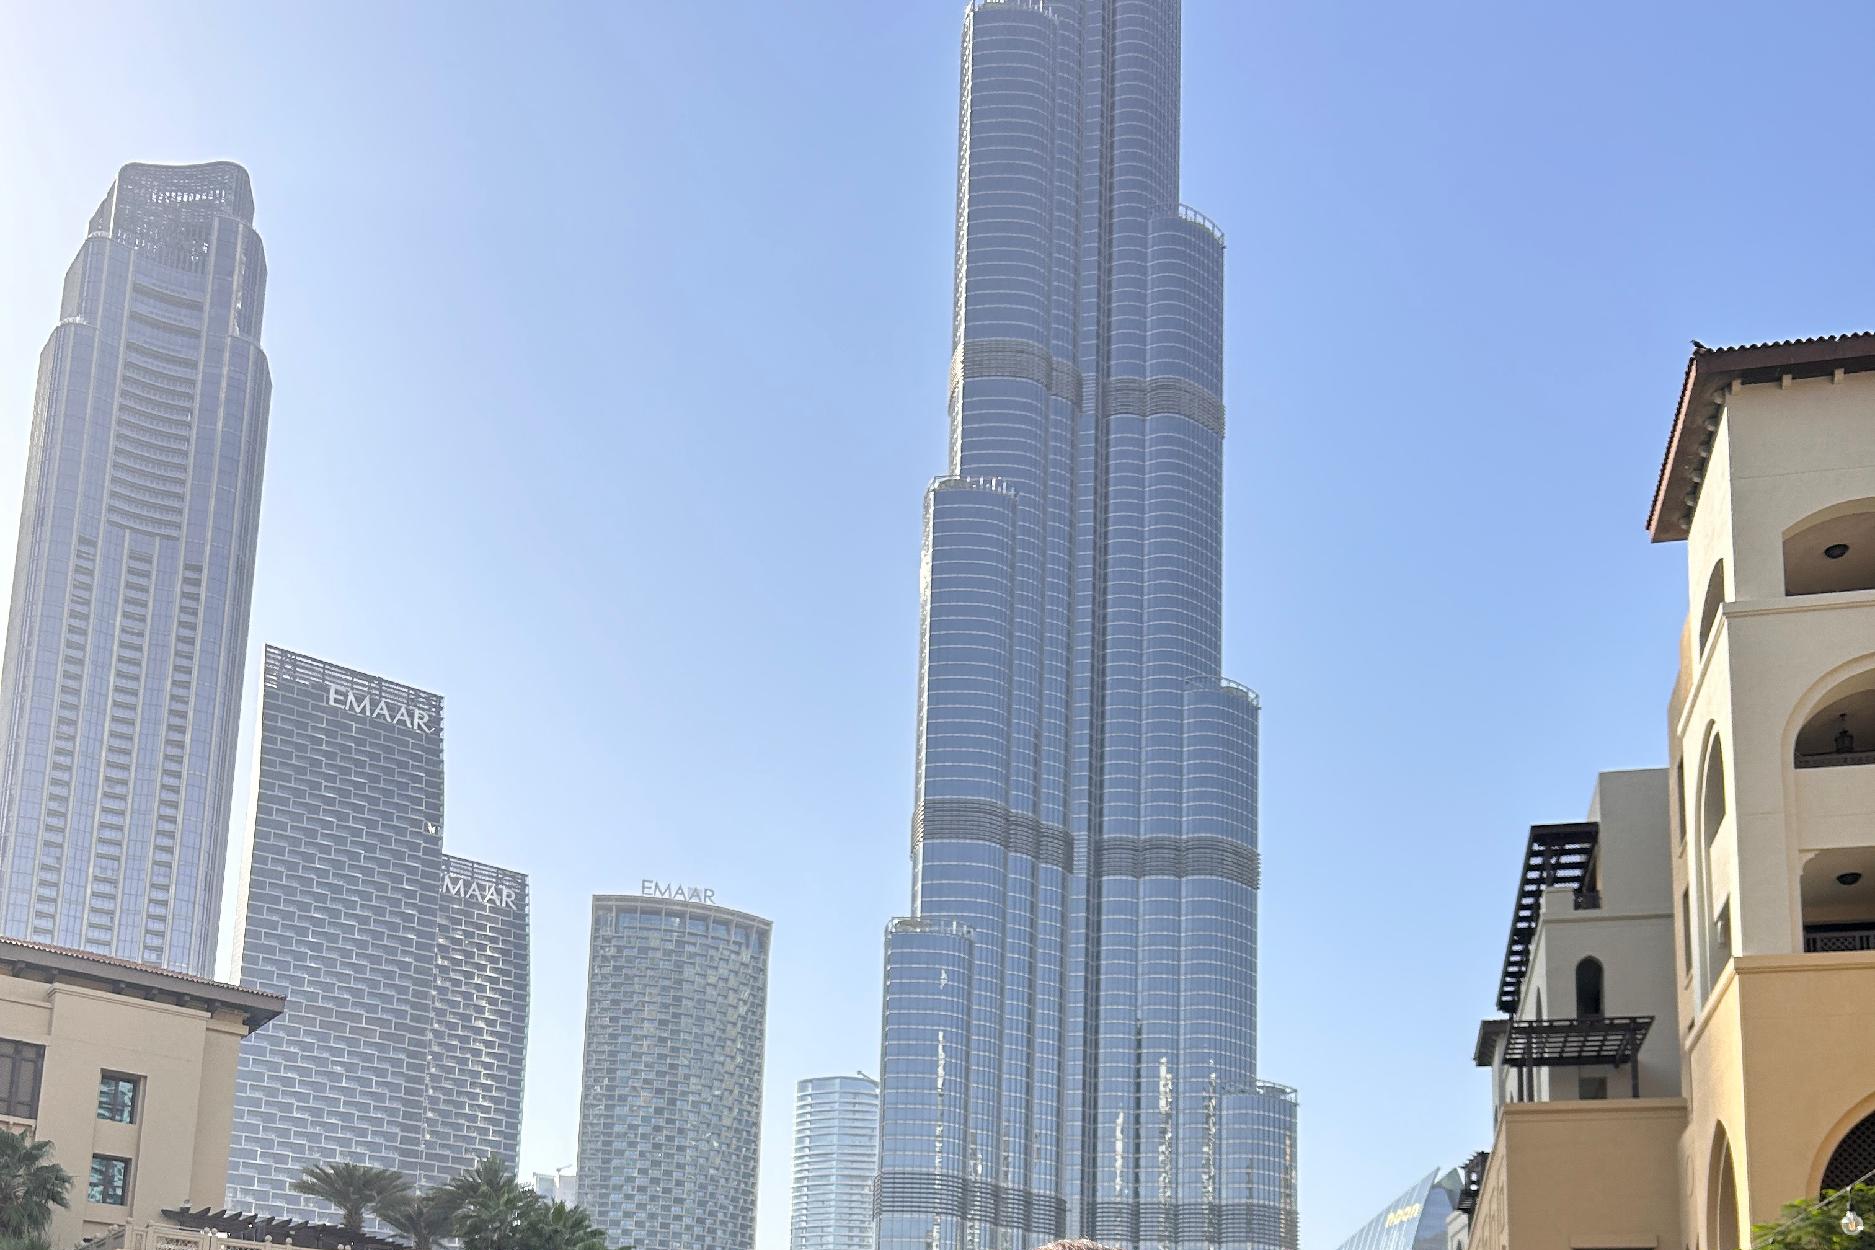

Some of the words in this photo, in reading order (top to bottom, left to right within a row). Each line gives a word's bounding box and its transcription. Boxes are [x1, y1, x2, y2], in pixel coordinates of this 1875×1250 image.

[328, 684, 434, 734] EMAAR
[440, 873, 517, 911] MAAR
[641, 879, 716, 904] EMAAR
